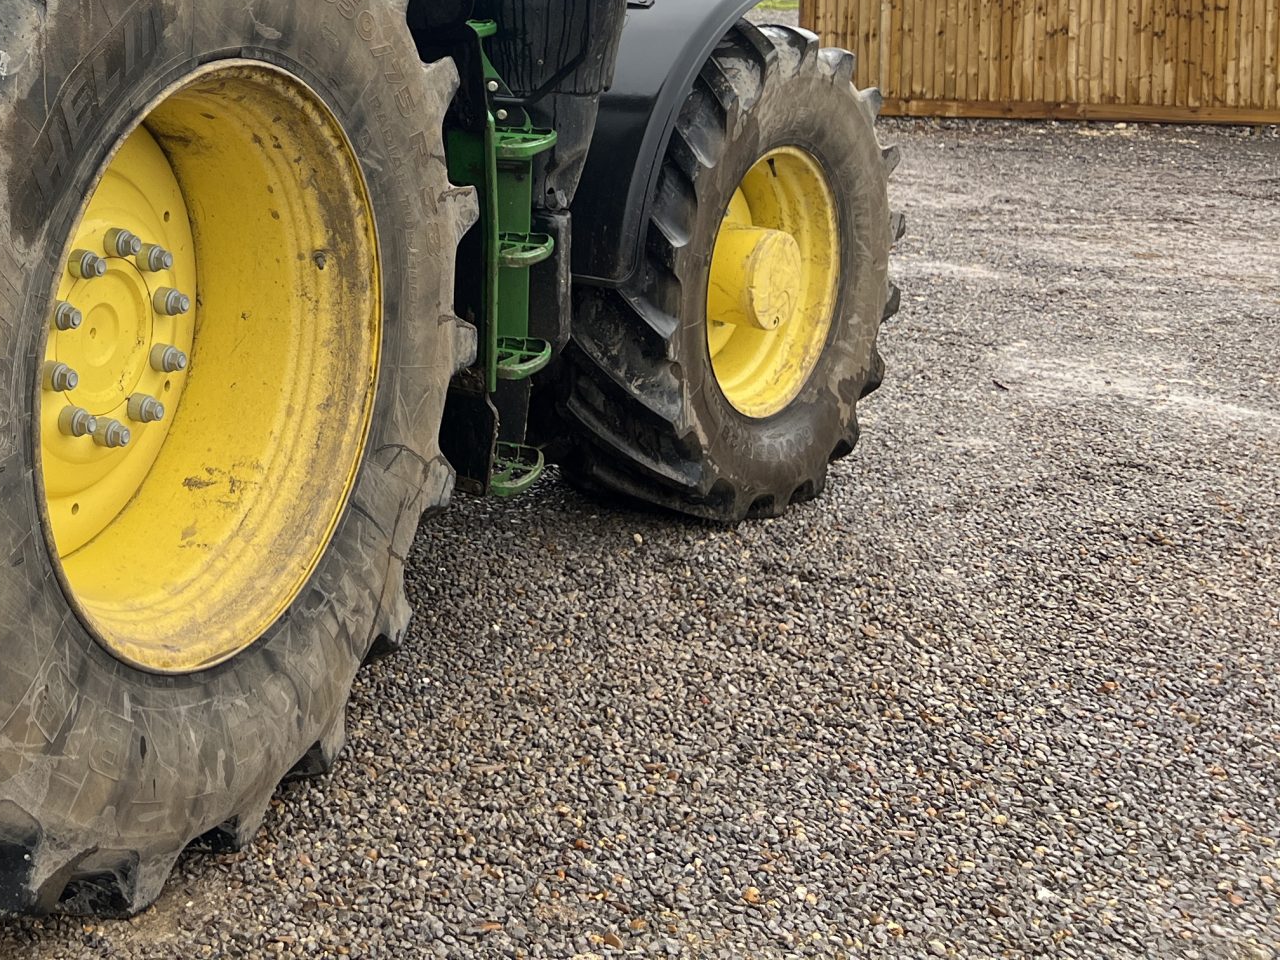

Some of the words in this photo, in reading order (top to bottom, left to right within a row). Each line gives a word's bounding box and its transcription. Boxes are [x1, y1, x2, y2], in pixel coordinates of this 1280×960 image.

[369, 95, 407, 188] RADIAL
[409, 129, 431, 169] R
[420, 186, 442, 258] 38
